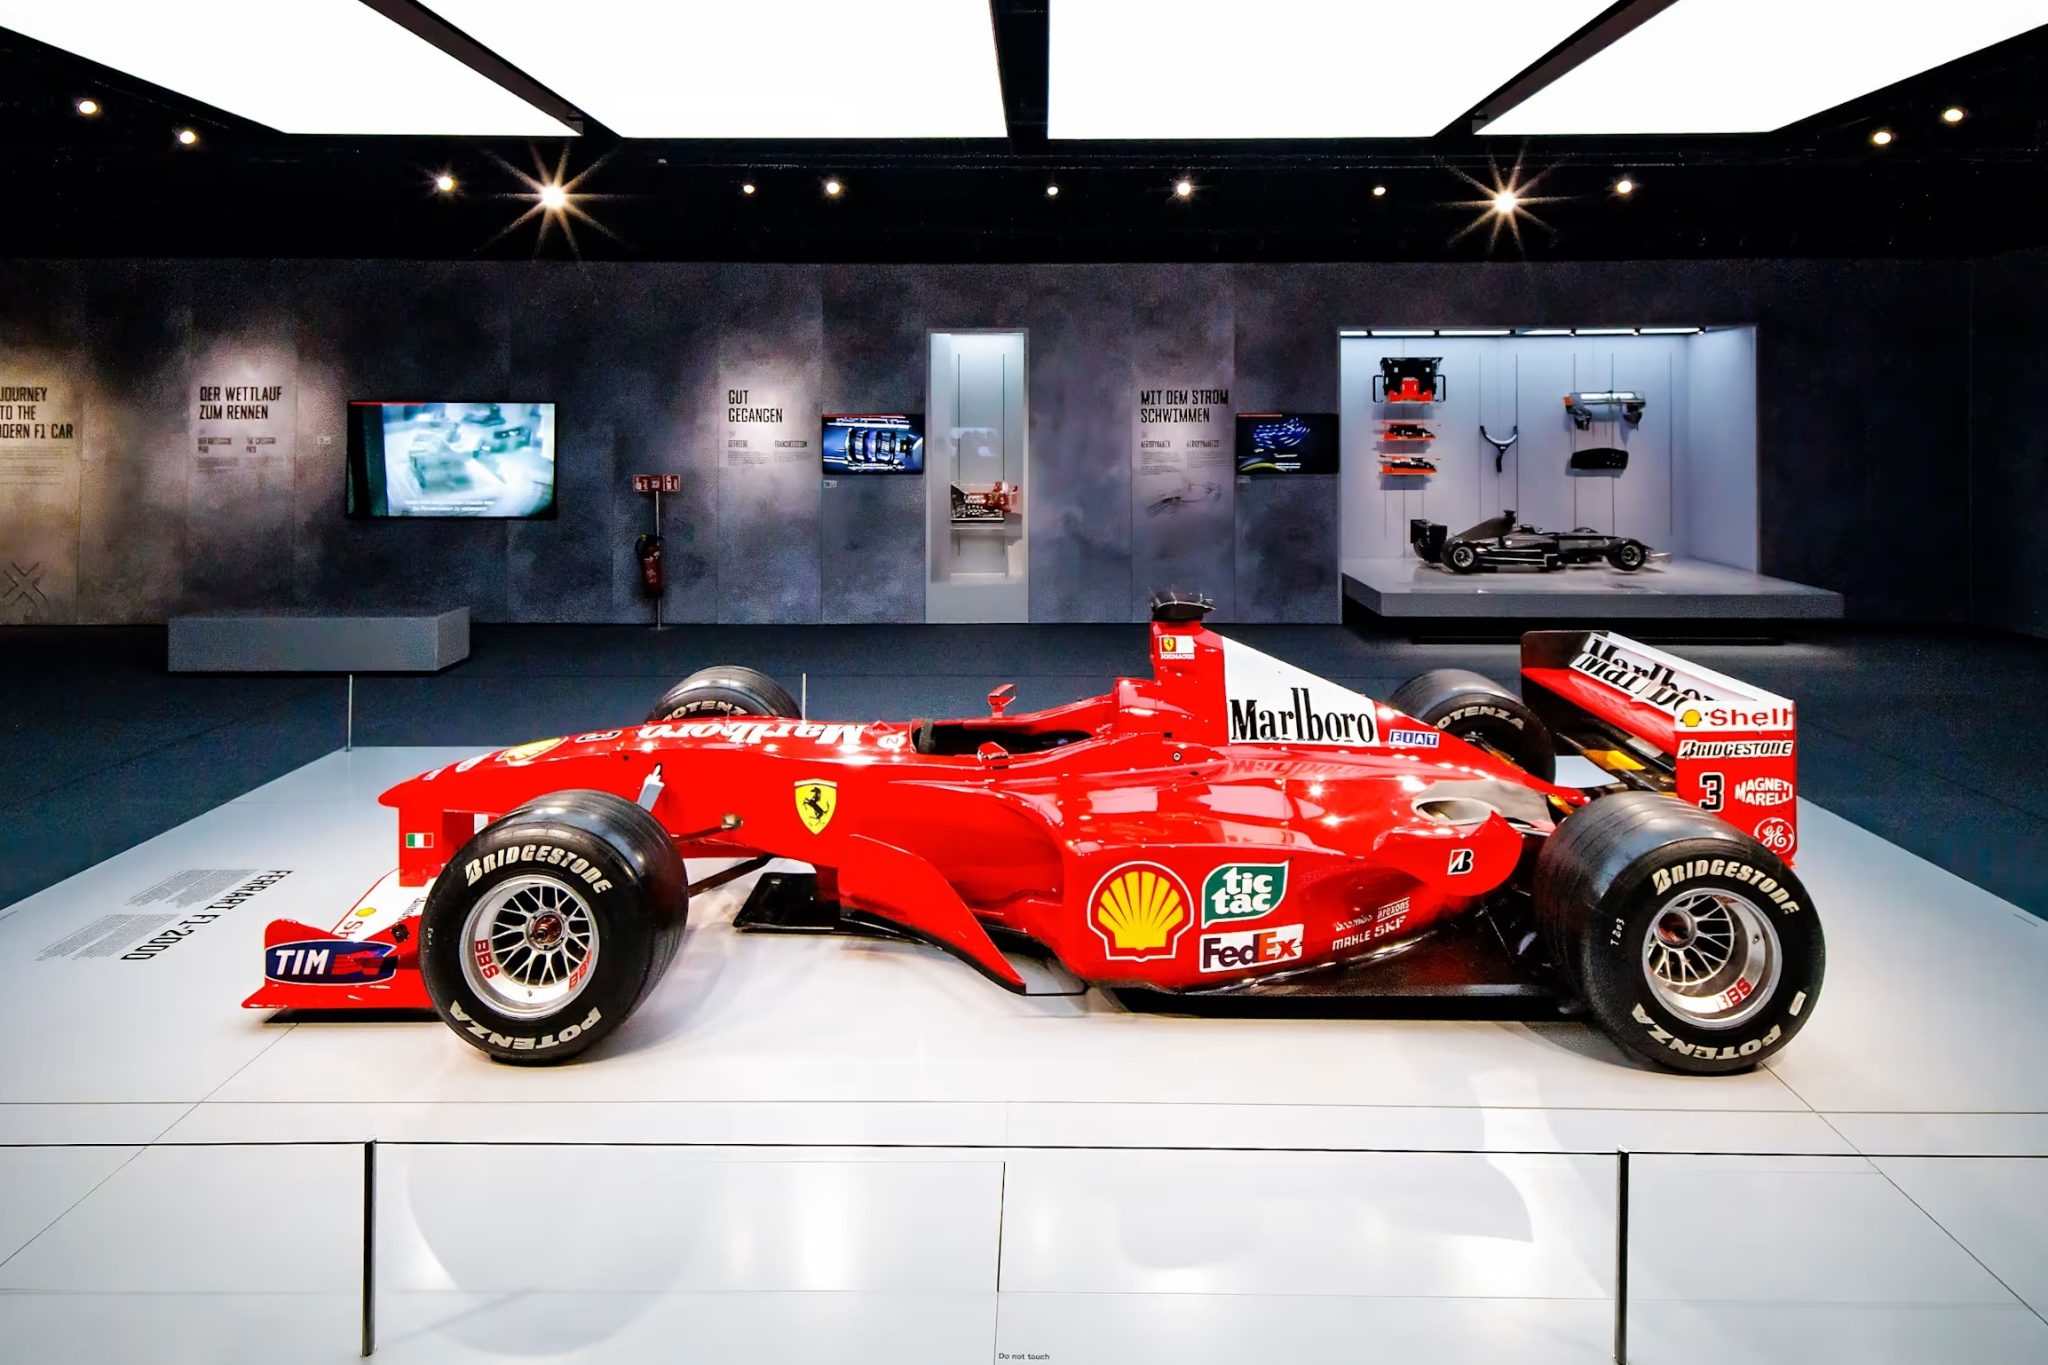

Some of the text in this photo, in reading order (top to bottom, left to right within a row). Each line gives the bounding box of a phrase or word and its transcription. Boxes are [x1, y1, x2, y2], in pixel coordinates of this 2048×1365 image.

[0, 387, 47, 402] JOURNEY
[200, 386, 282, 401] DER WETTLAUF
[728, 389, 749, 404] GUT
[1141, 389, 1229, 405] MIT DEM STROM
[0, 405, 36, 420] TO THE
[200, 405, 268, 419] ZUM RENNEN
[728, 408, 783, 423] GEGANGEN
[1141, 408, 1210, 423] SCHWIMMEN
[0, 423, 74, 439] DERN F1 CAR
[662, 700, 748, 721] OTENZ
[1230, 687, 1374, 743] Marlboro
[1434, 706, 1524, 731] OTENZA
[1710, 708, 1788, 726] Shell
[638, 723, 868, 746] Marlboro
[1391, 731, 1438, 746] FIAT
[1679, 740, 1793, 758] BRIDGESTONE
[1700, 773, 1724, 811] 3
[465, 844, 613, 894] BRIDGESTONE
[205, 870, 293, 910] FERRARI
[1223, 867, 1273, 895] tic
[1652, 859, 1799, 915] BRIDGESTONE
[1211, 887, 1272, 915] tac
[120, 914, 221, 960] F1-2000
[1374, 915, 1407, 938] SKF
[1203, 931, 1297, 969] FedEx
[1332, 930, 1371, 951] MAHLE
[275, 949, 330, 975] TIM
[475, 939, 499, 979] BBS
[450, 1000, 602, 1050] POTENZA
[1632, 1002, 1781, 1060] POTENZA
